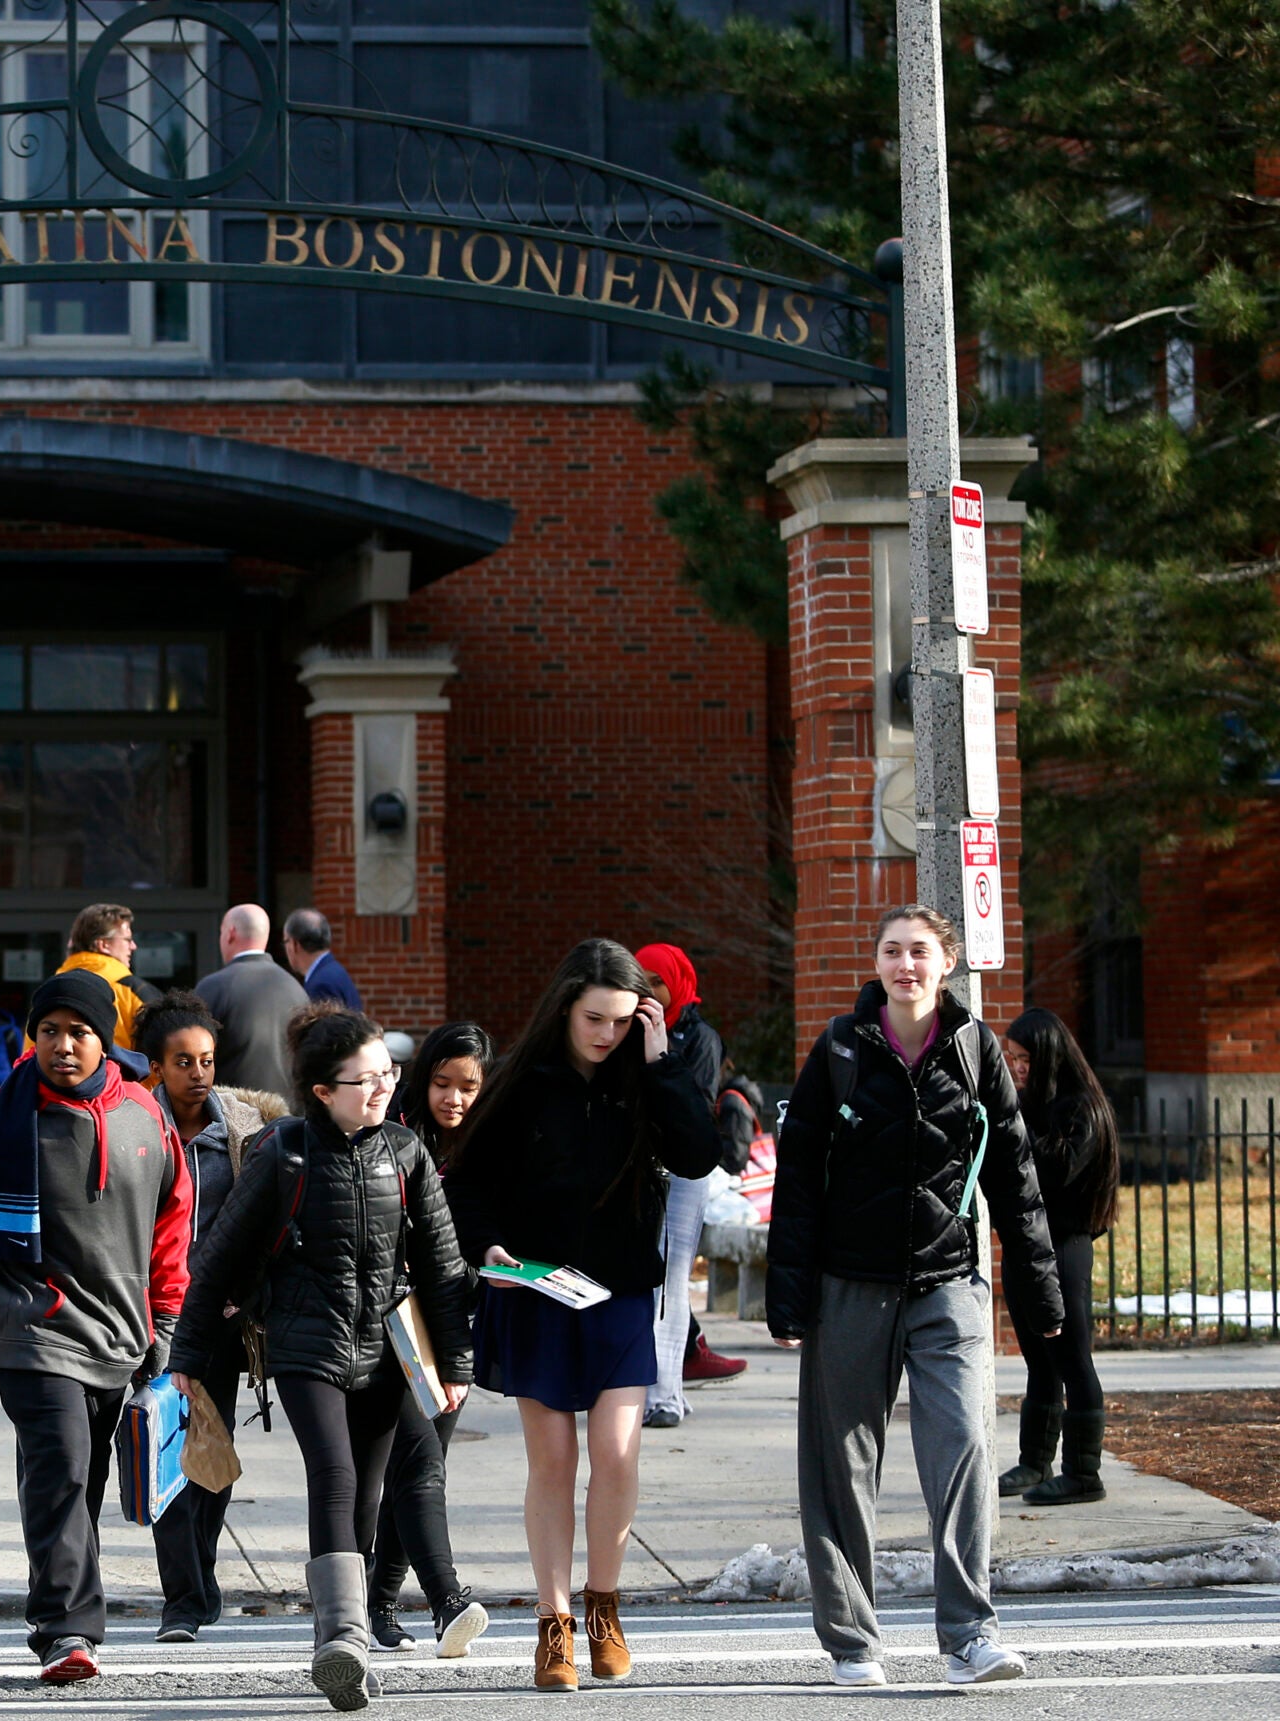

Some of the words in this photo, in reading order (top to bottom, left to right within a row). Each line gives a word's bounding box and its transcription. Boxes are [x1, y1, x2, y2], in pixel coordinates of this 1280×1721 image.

[261, 210, 815, 347] BOSTONIENSIS
[953, 496, 967, 519] TOW
[966, 498, 982, 522] ZONE
[962, 530, 974, 549] NO
[956, 551, 983, 567] STOPPING
[963, 826, 979, 843] TOW
[980, 826, 996, 843] ZONE
